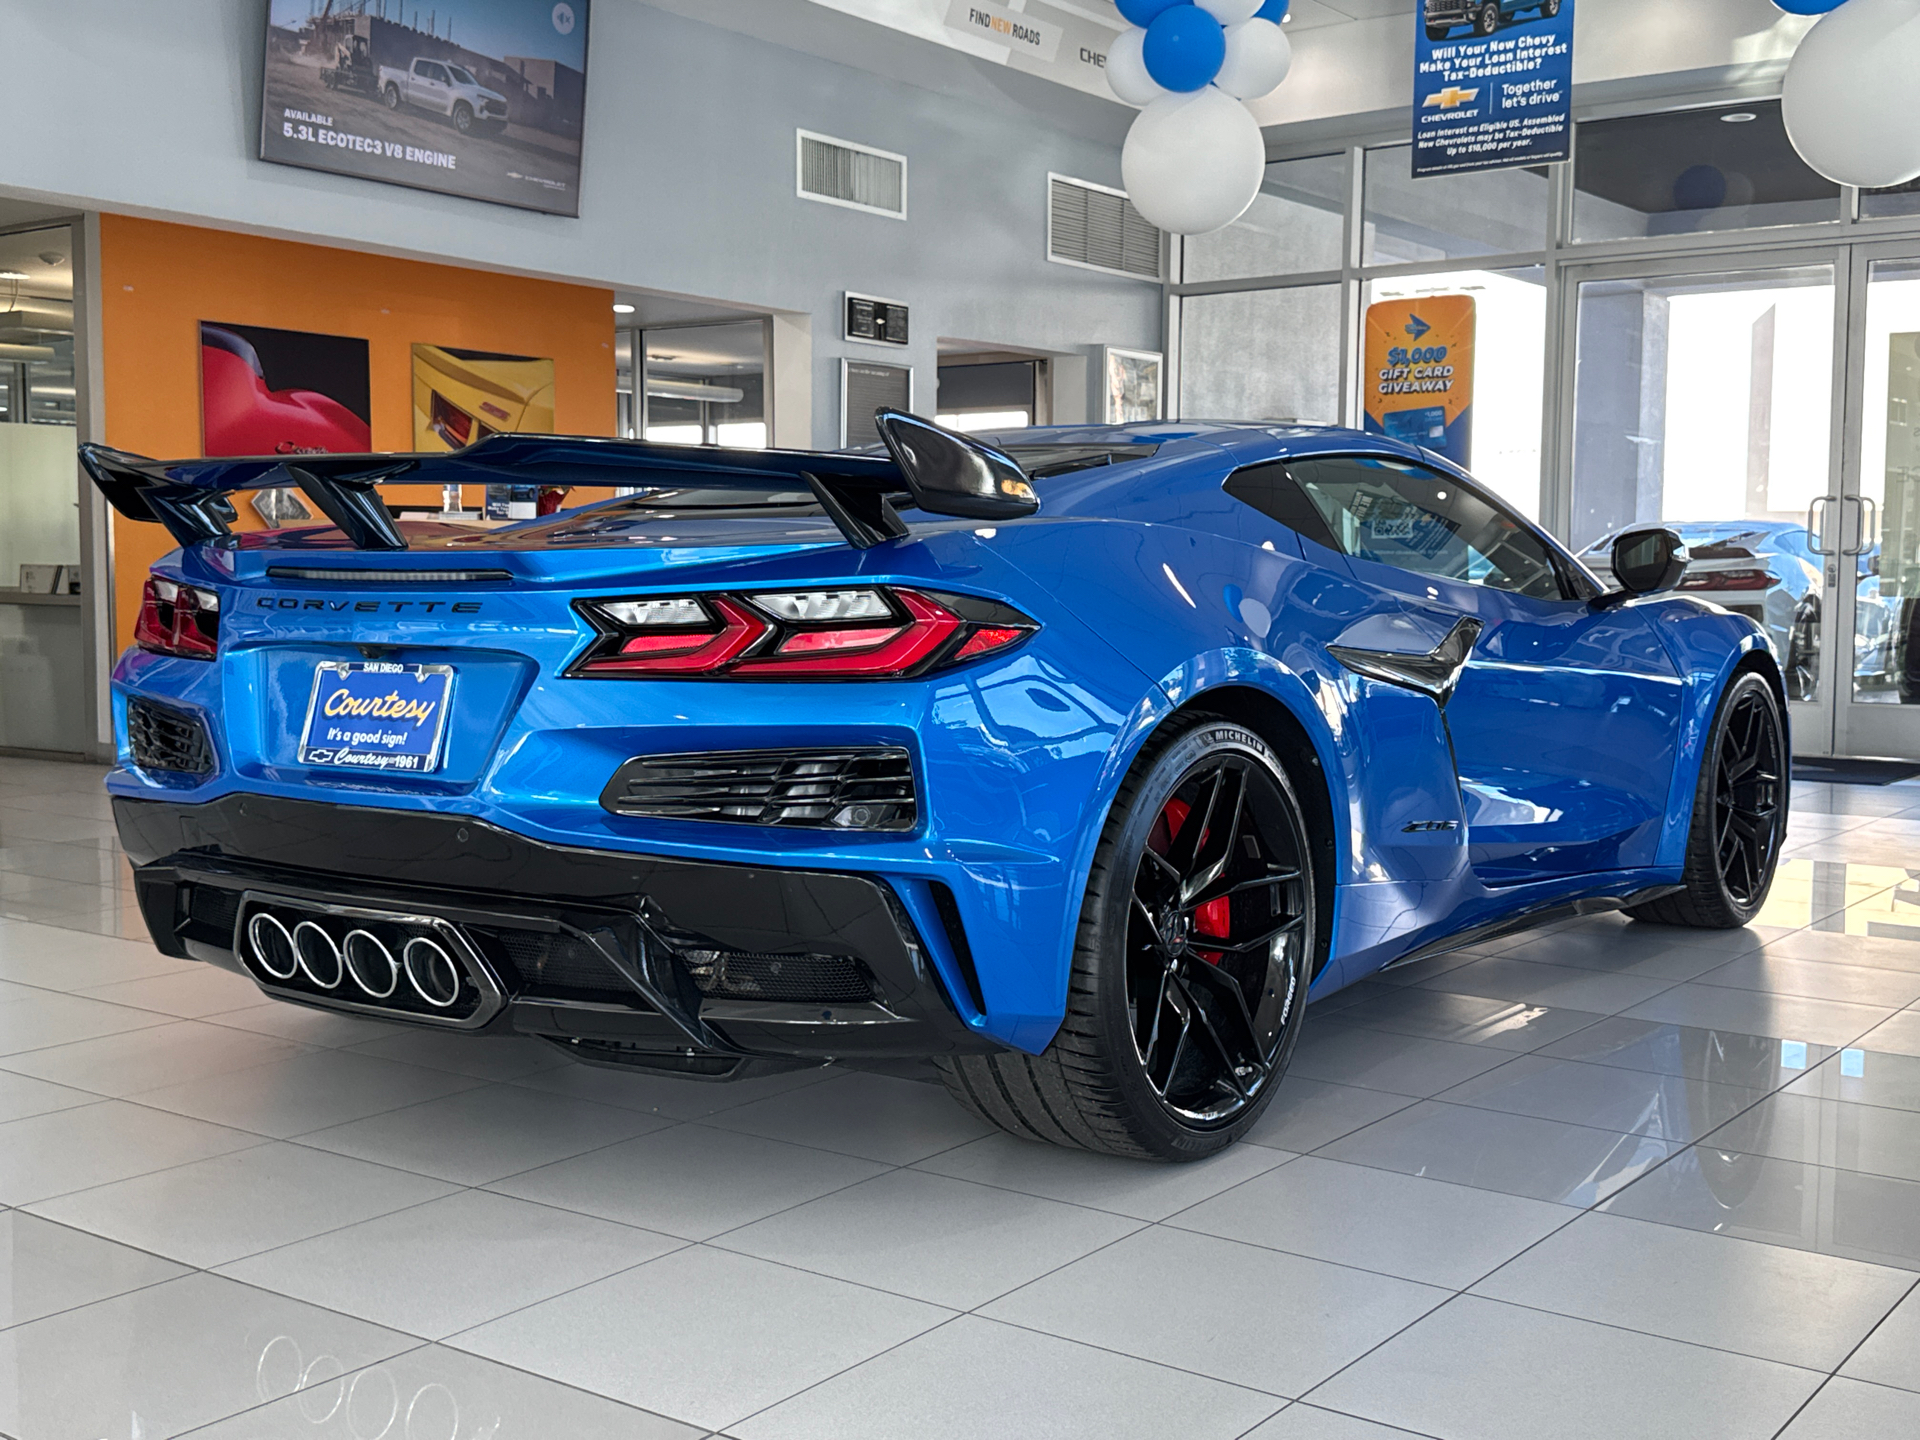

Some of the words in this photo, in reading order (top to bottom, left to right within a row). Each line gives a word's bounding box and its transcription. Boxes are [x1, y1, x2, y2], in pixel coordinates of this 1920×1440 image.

[969, 8, 991, 28] FIND
[991, 15, 1012, 35] NEW
[1012, 24, 1041, 46] ROADS
[1079, 47, 1107, 69] CHE
[1419, 62, 1451, 73] Make
[1454, 56, 1482, 68] Your
[1485, 53, 1514, 65] Loan
[1516, 43, 1568, 60] Interest
[1432, 46, 1456, 60] Will
[1458, 44, 1487, 58] Your
[1490, 40, 1515, 52] New
[1518, 34, 1556, 48] Chevy
[1443, 58, 1542, 82] Tax-Deductible?
[1502, 79, 1557, 97] Together
[1502, 95, 1527, 109] let's
[284, 108, 334, 126] AVAILABLE
[1417, 131, 1436, 139] Loan
[1437, 126, 1468, 137] Interest
[1479, 121, 1508, 133] Eligible
[1522, 112, 1566, 126] Assembled
[1421, 109, 1479, 123] CHEVROLET
[283, 122, 316, 142] 5.3L
[318, 130, 383, 155] ECOTEC3
[384, 142, 403, 159] V8
[405, 146, 457, 169] ENGINE
[1418, 141, 1435, 149] New
[1435, 135, 1476, 147] Chevrolets
[1476, 134, 1494, 143] may
[1494, 132, 1504, 140] be
[1505, 124, 1564, 138] Tax-Deductible
[1446, 147, 1458, 157] Up
[1458, 146, 1467, 154] to
[1467, 141, 1498, 153] $10,000
[1498, 141, 1511, 151] per
[1511, 138, 1533, 149] year.
[1387, 345, 1448, 367] $1,000
[1378, 367, 1410, 381] GIFT
[1414, 365, 1454, 379] CARD
[1378, 379, 1455, 394] GIVEAWAY
[256, 597, 483, 613] CORVETTE
[363, 662, 379, 673] SAN
[380, 663, 404, 674] DIEGO
[324, 688, 436, 728] Courtesy
[327, 728, 342, 741] It's
[343, 732, 351, 741] a
[351, 730, 383, 746] good
[383, 732, 408, 748] sign!
[1215, 730, 1263, 752] MICHELIN
[333, 747, 390, 770] Courtesy
[395, 755, 419, 769] 1961
[1401, 820, 1459, 833] Z06
[1280, 976, 1296, 1026] FORGED
